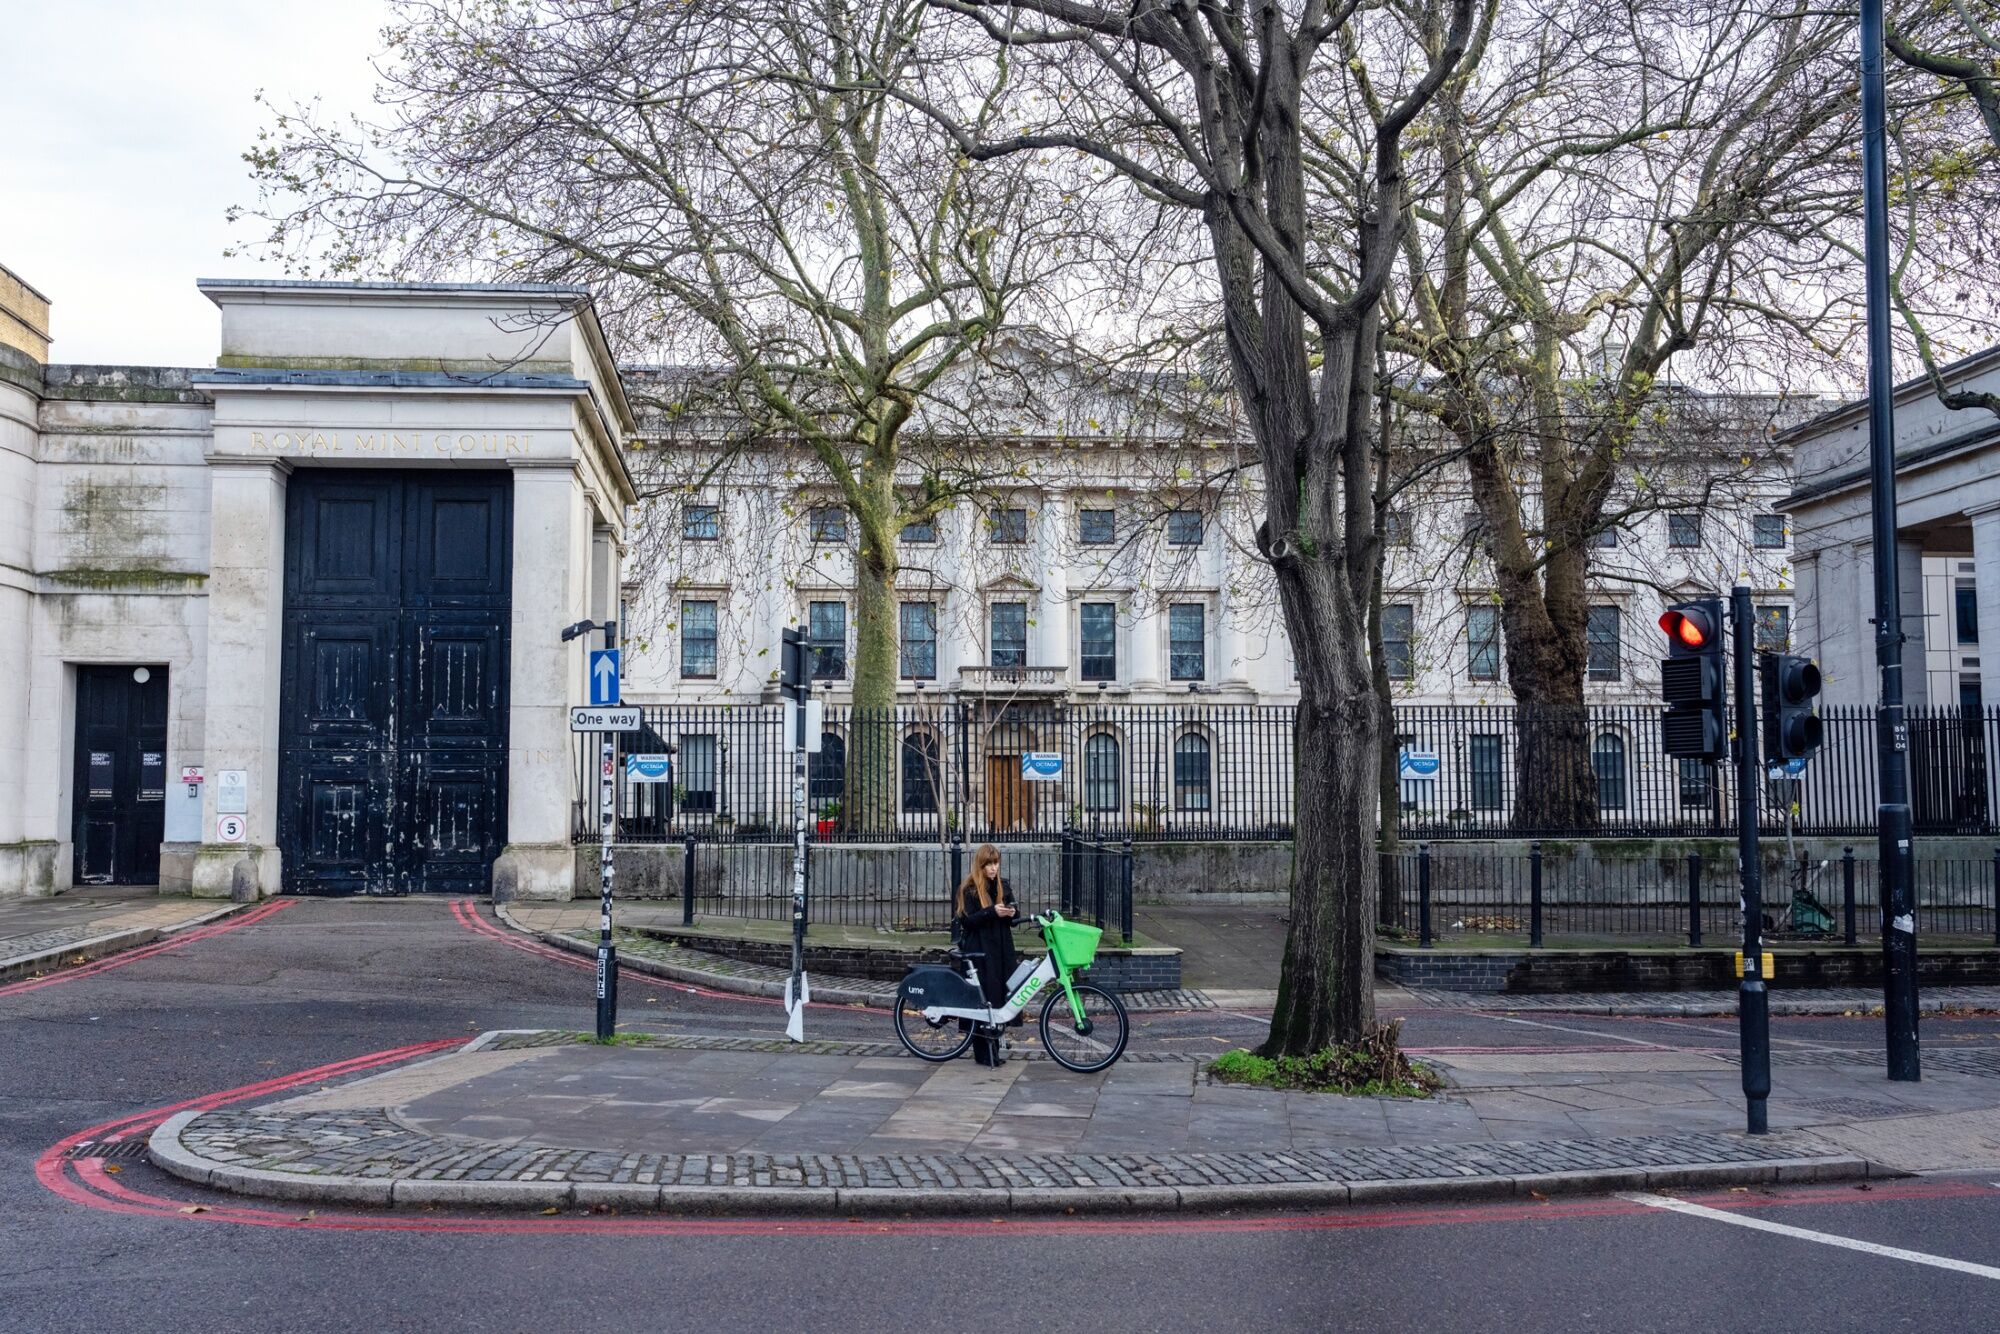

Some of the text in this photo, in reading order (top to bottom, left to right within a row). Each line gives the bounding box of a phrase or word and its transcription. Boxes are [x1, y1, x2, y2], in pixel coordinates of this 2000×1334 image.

[251, 432, 533, 452] ROYAL MINT COURT
[576, 712, 636, 727] One way
[523, 750, 550, 764] IN
[227, 822, 237, 835] 5
[908, 986, 925, 995] Lime
[1011, 977, 1041, 1007] Lime
